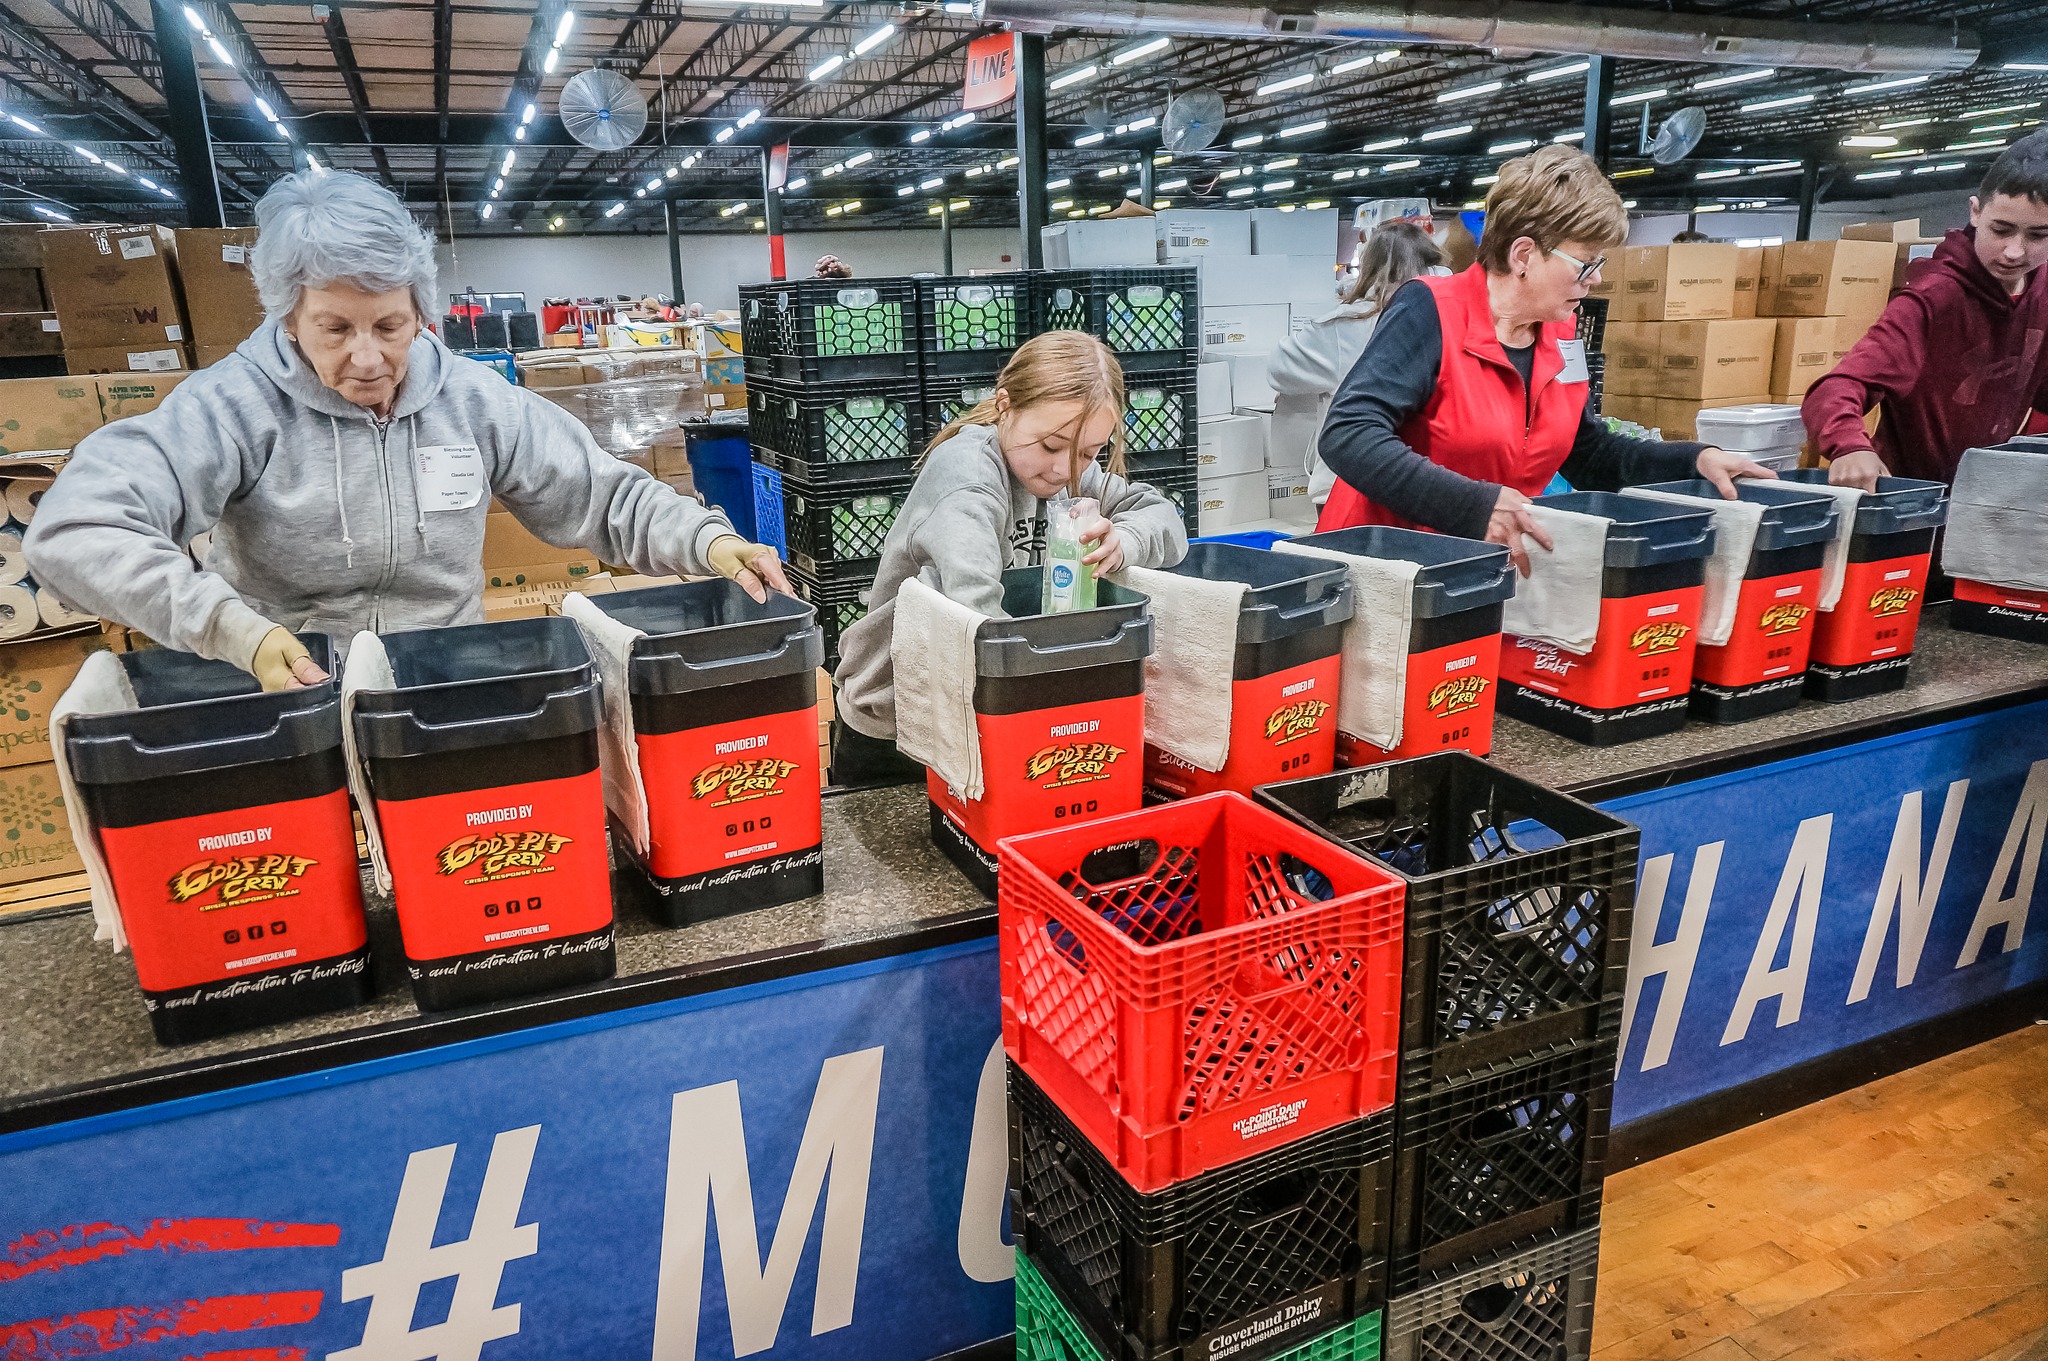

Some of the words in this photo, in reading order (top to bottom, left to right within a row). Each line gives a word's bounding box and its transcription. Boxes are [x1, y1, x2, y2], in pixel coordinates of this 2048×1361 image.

[970, 48, 1010, 87] LINE
[1054, 568, 1070, 578] White
[1282, 680, 1307, 698] PROVIDED
[1308, 678, 1316, 690] BY
[1051, 722, 1088, 737] PROVIDED
[1089, 720, 1100, 732] BY
[715, 737, 756, 755] PROVIDED
[757, 734, 769, 747] BY
[755, 758, 800, 779] PIT
[1058, 761, 1104, 781] CREW
[727, 776, 776, 798] CREW
[466, 807, 517, 826] PROVIDED
[519, 805, 533, 819] BY
[199, 829, 255, 852] PROVIDED
[255, 827, 272, 842] BY
[518, 831, 573, 854] PIT
[260, 854, 319, 877] PIT
[482, 851, 546, 875] CREW
[679, 876, 706, 893] and
[708, 864, 768, 887] restoration
[770, 859, 786, 873] to
[786, 850, 822, 869] hurting
[221, 874, 289, 900] CREW
[464, 876, 489, 885] CRISIS
[490, 869, 531, 881] RESPONSE
[533, 866, 555, 874] TEAM
[275, 888, 300, 898] TEAM
[429, 961, 461, 978] and
[465, 949, 540, 972] restoration
[542, 943, 562, 959] to
[562, 934, 610, 955] hurting
[165, 989, 202, 1008] and
[205, 975, 287, 1001] restoration
[290, 968, 312, 985] to
[311, 957, 365, 980] hurting
[1233, 1109, 1279, 1131] HY-POINT
[1279, 1099, 1308, 1116] DAIRY
[1208, 1310, 1282, 1352] Cloverland
[1285, 1296, 1323, 1320] Dairy
[1209, 1343, 1240, 1361] MISUSE
[1240, 1322, 1290, 1350] PUNISHABLE
[1290, 1316, 1303, 1329] BY
[1302, 1309, 1321, 1323] LAW
